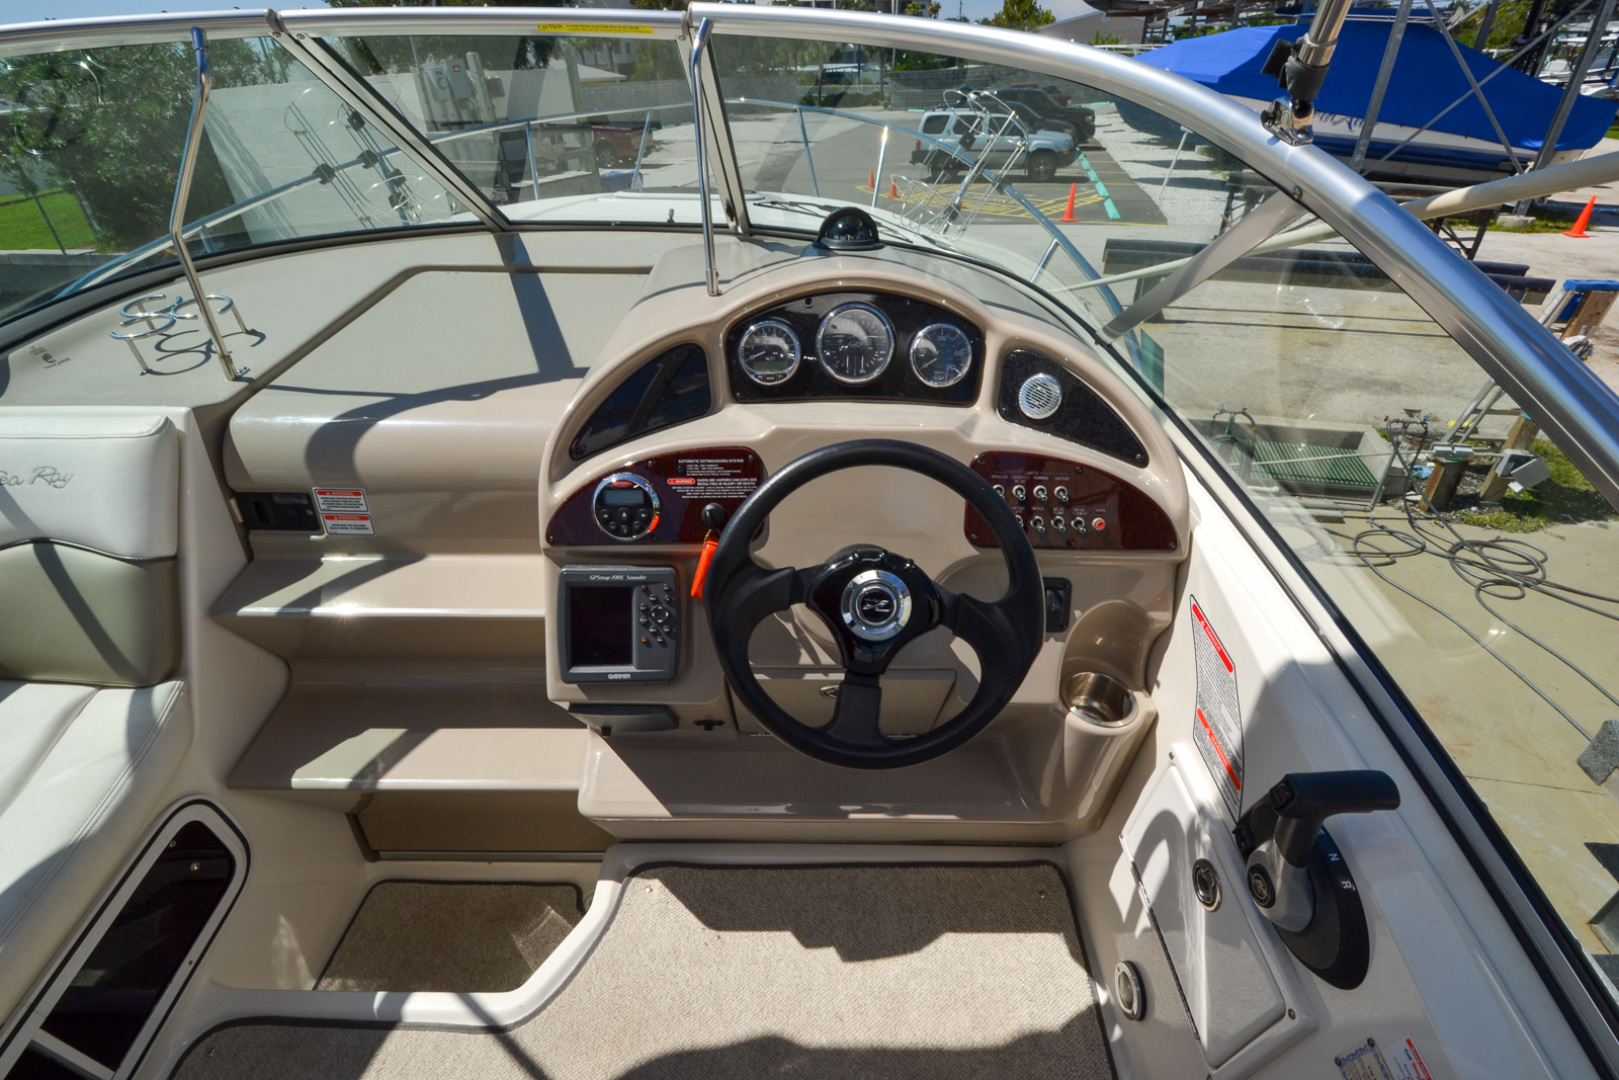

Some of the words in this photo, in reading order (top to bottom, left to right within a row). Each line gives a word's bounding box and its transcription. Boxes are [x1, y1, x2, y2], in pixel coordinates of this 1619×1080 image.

[28, 466, 75, 489] Ray
[1204, 625, 1221, 652] DANGER
[1209, 732, 1230, 768] WARNING
[1341, 880, 1352, 889] R
